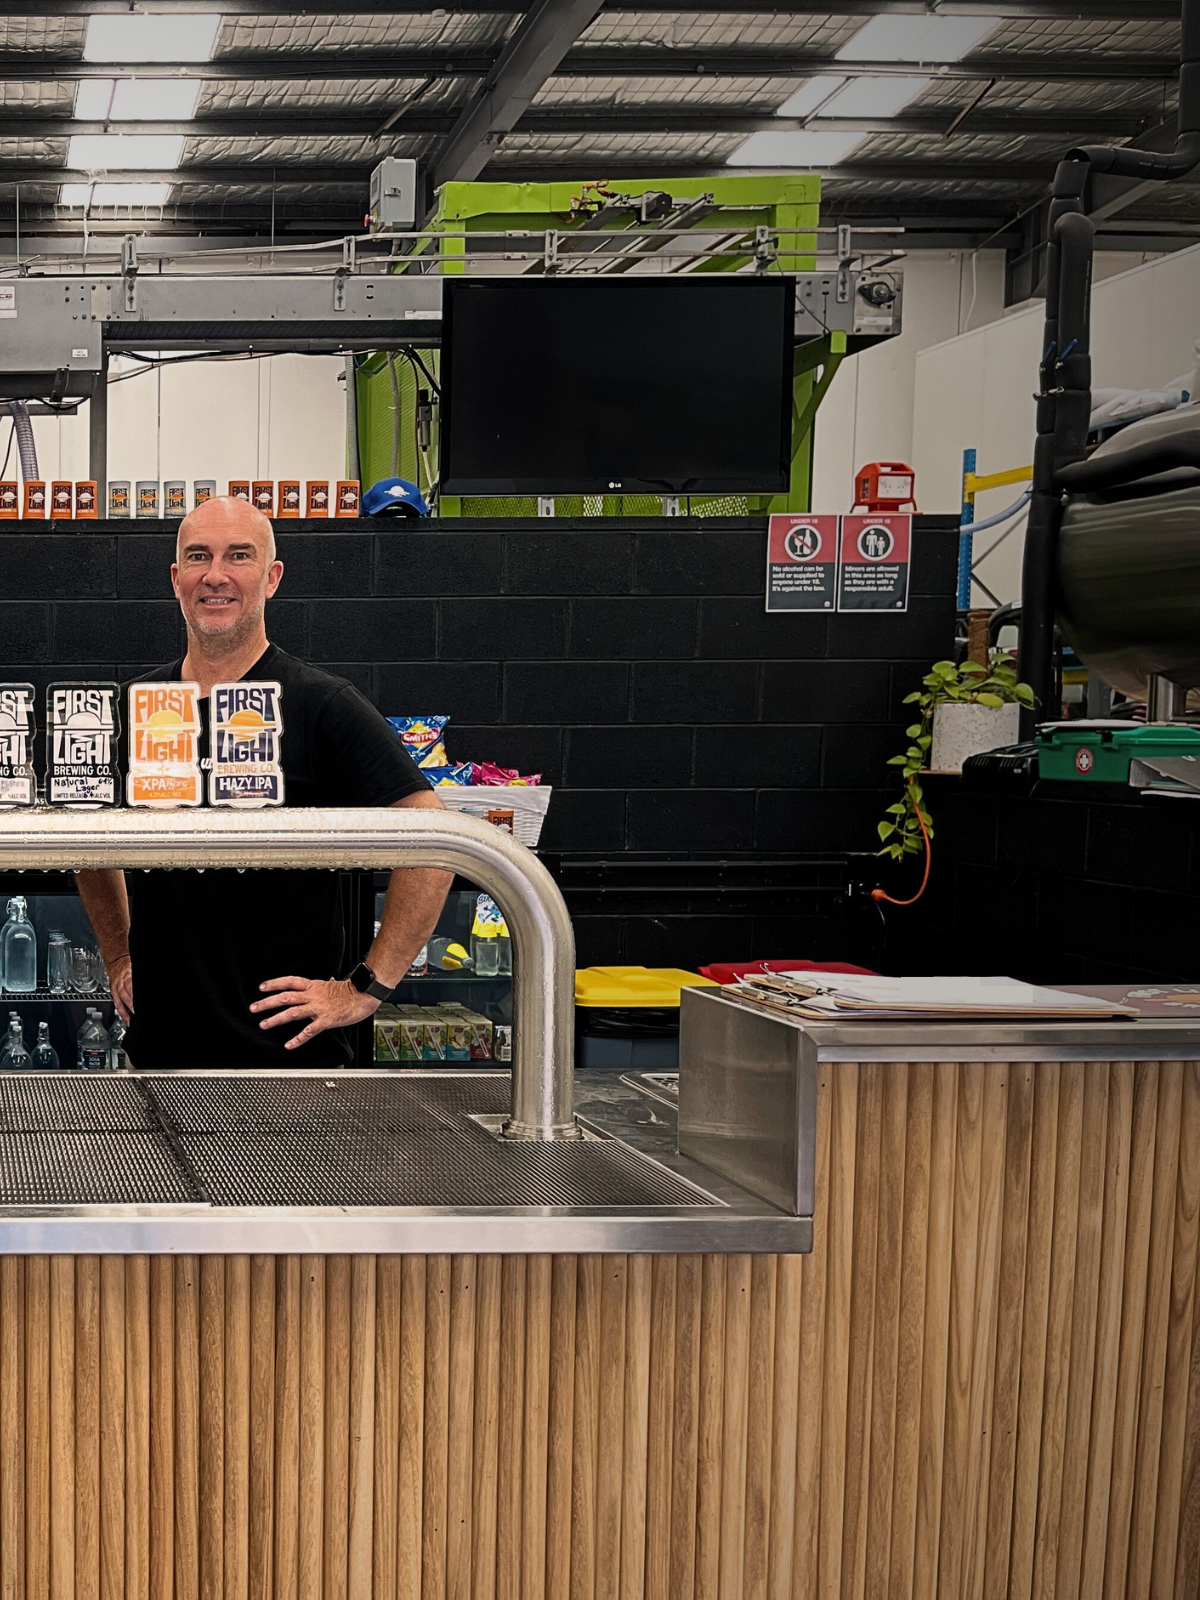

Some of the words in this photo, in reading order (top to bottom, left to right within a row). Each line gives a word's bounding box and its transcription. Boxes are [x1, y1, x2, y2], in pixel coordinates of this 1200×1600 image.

[793, 572, 818, 580] supplied
[53, 690, 114, 725] FIRST
[135, 689, 194, 723] FIRST
[216, 688, 276, 723] FIRST
[53, 730, 114, 765] LIGHT
[135, 729, 195, 764] LIGHT
[216, 728, 276, 764] LIGHT
[13, 766, 28, 777] CO.
[54, 765, 94, 776] BREWING
[96, 765, 112, 776] CO.
[217, 764, 257, 775] BREWING
[54, 776, 88, 788] Natural
[75, 784, 100, 794] Lager
[141, 777, 167, 791] XPA
[219, 777, 252, 791] HAZY
[254, 776, 274, 790] IPA
